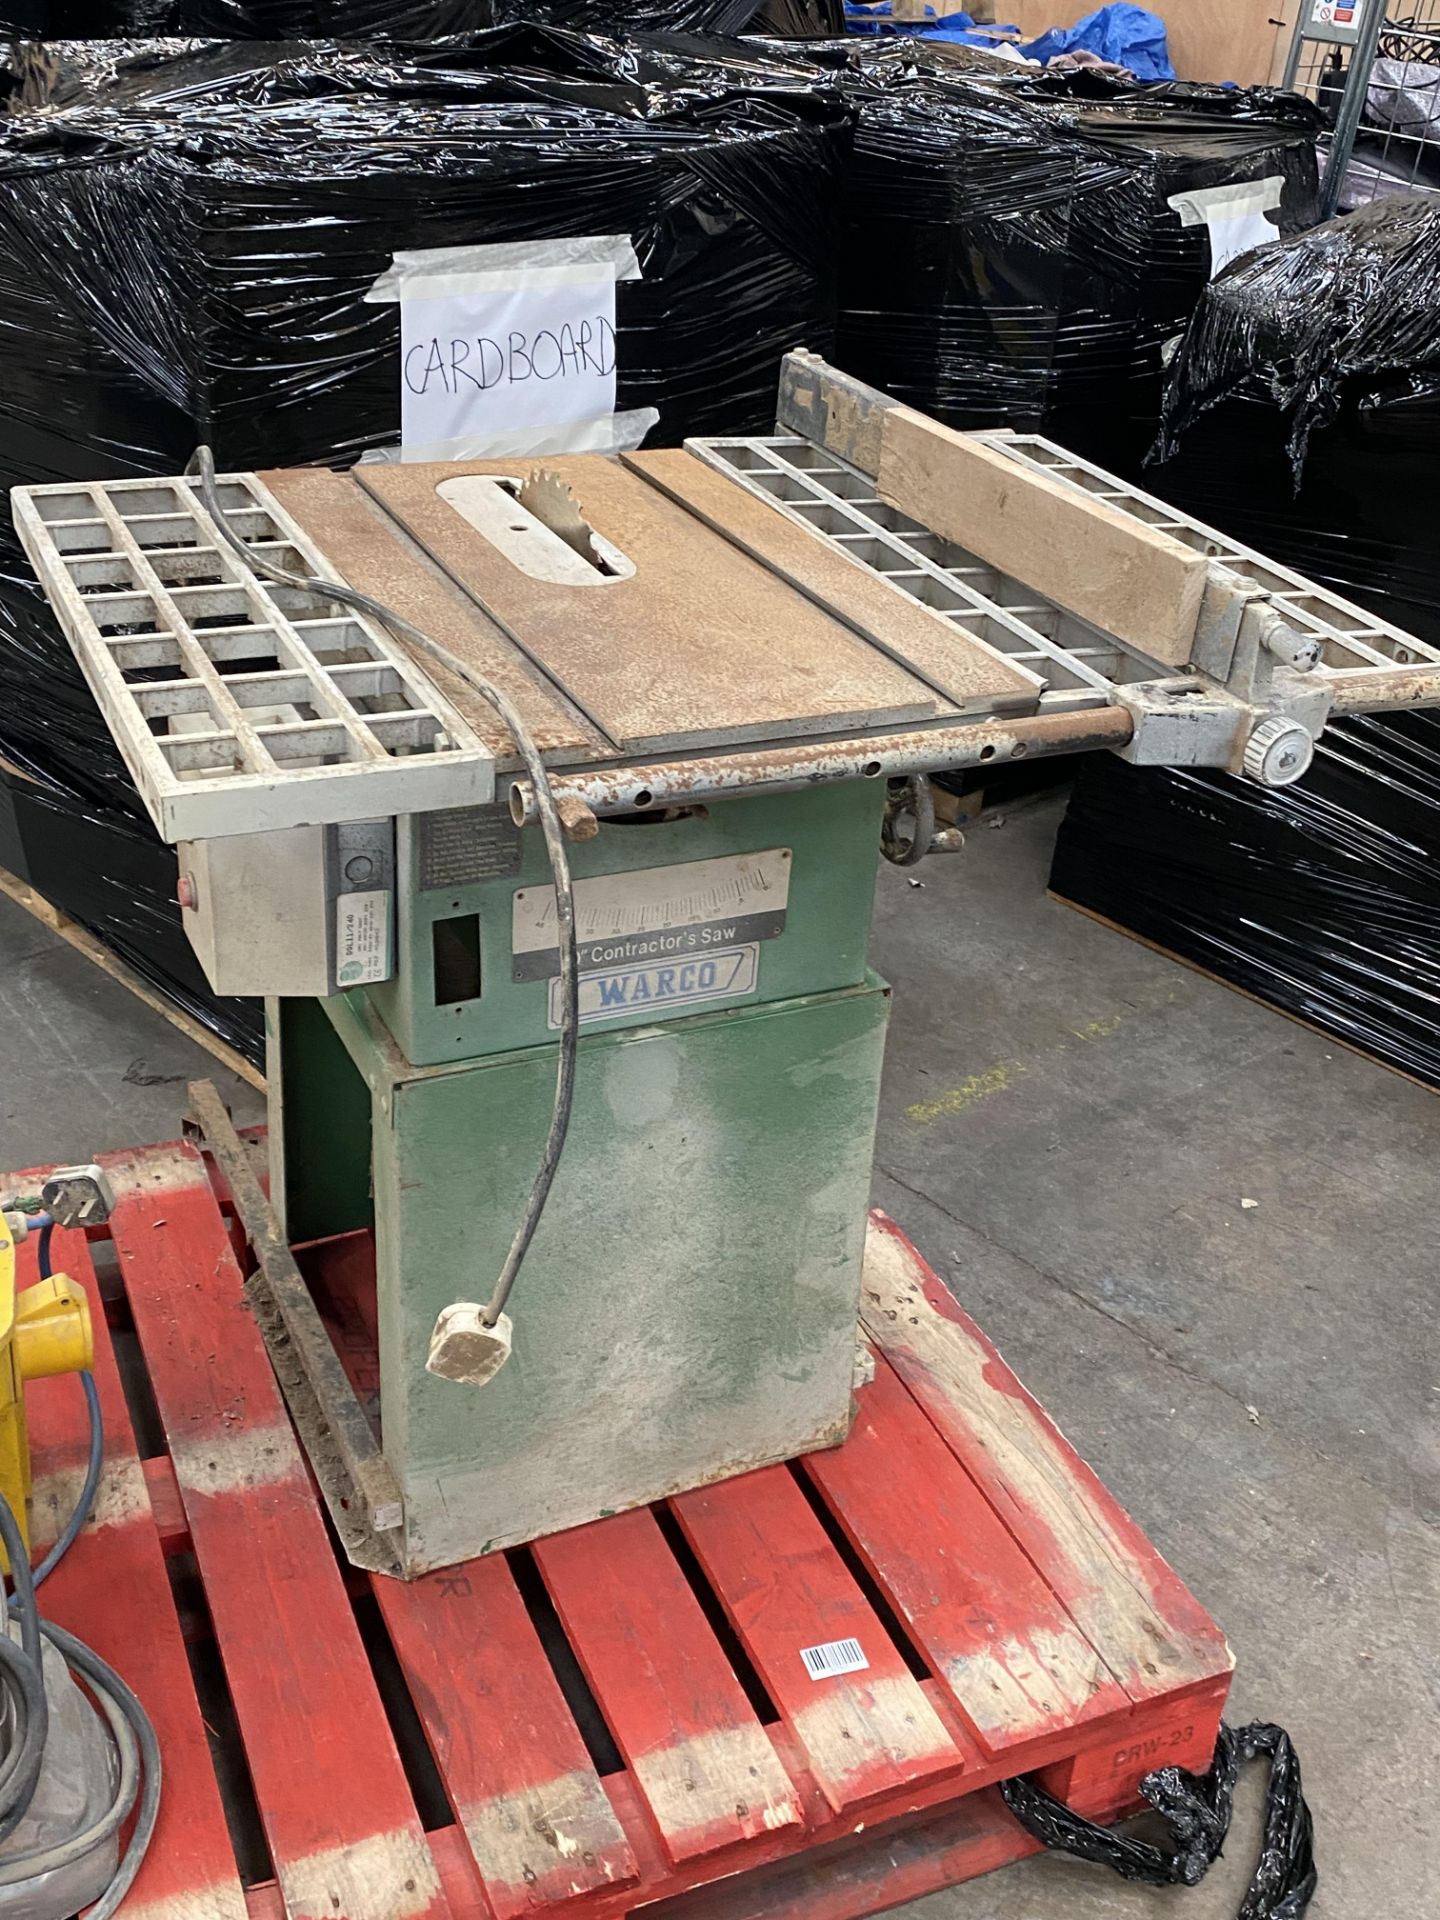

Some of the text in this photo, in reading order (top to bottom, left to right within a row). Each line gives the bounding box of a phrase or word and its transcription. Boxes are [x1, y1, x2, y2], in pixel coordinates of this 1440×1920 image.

[404, 315, 617, 394] CARDBOARD
[591, 931, 697, 963] Contractor's
[700, 926, 737, 945] Saw
[597, 961, 717, 1006] WARCO
